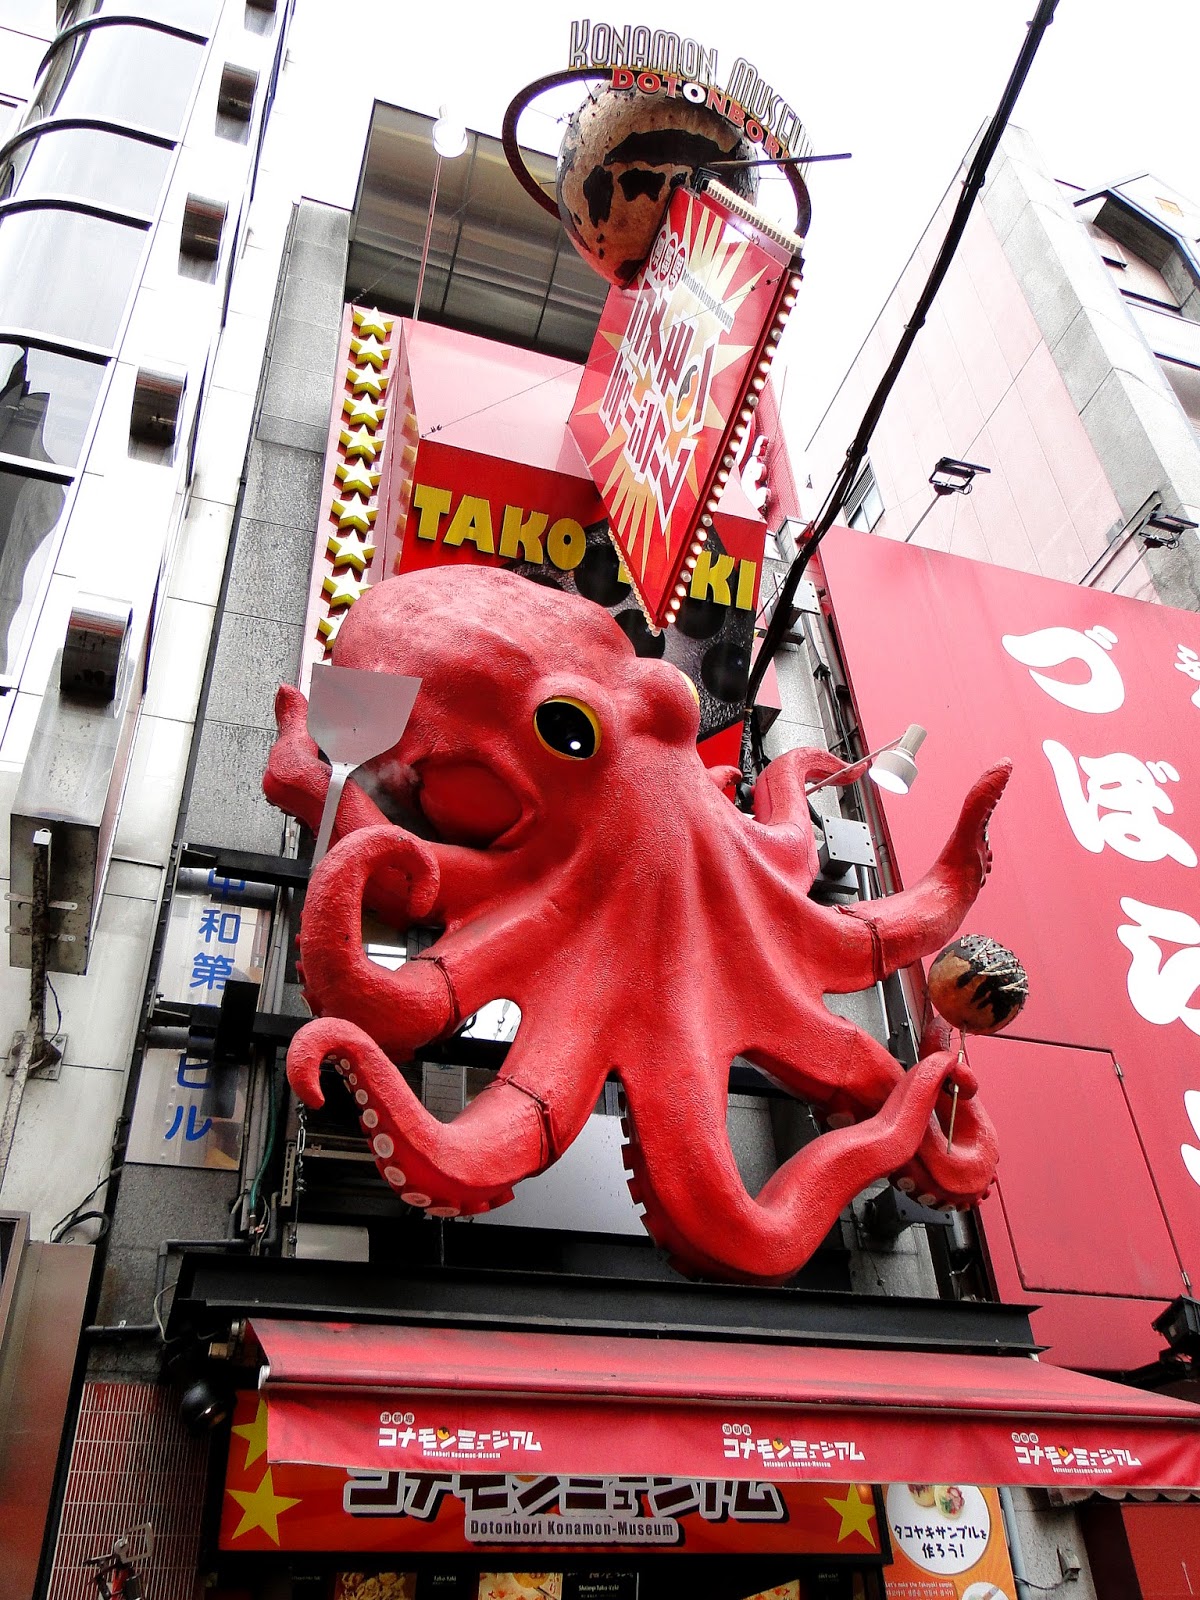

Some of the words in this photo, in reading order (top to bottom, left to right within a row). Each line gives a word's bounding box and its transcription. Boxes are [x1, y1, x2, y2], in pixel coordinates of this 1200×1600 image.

[569, 19, 718, 85] KONAMON
[611, 68, 790, 172] DOTONBORI
[414, 483, 756, 611] TAKOKI
[164, 868, 246, 1142] 中和第ビル
[378, 1427, 542, 1450] コナモンミュージアム
[723, 1438, 865, 1460] コナモンミュージアム
[1014, 1445, 1142, 1466] コナモンミュージアム
[471, 1520, 542, 1535] Dotonbori
[548, 1520, 673, 1536] Konamon-Museum
[894, 1525, 987, 1539] タコヤキサンプルを
